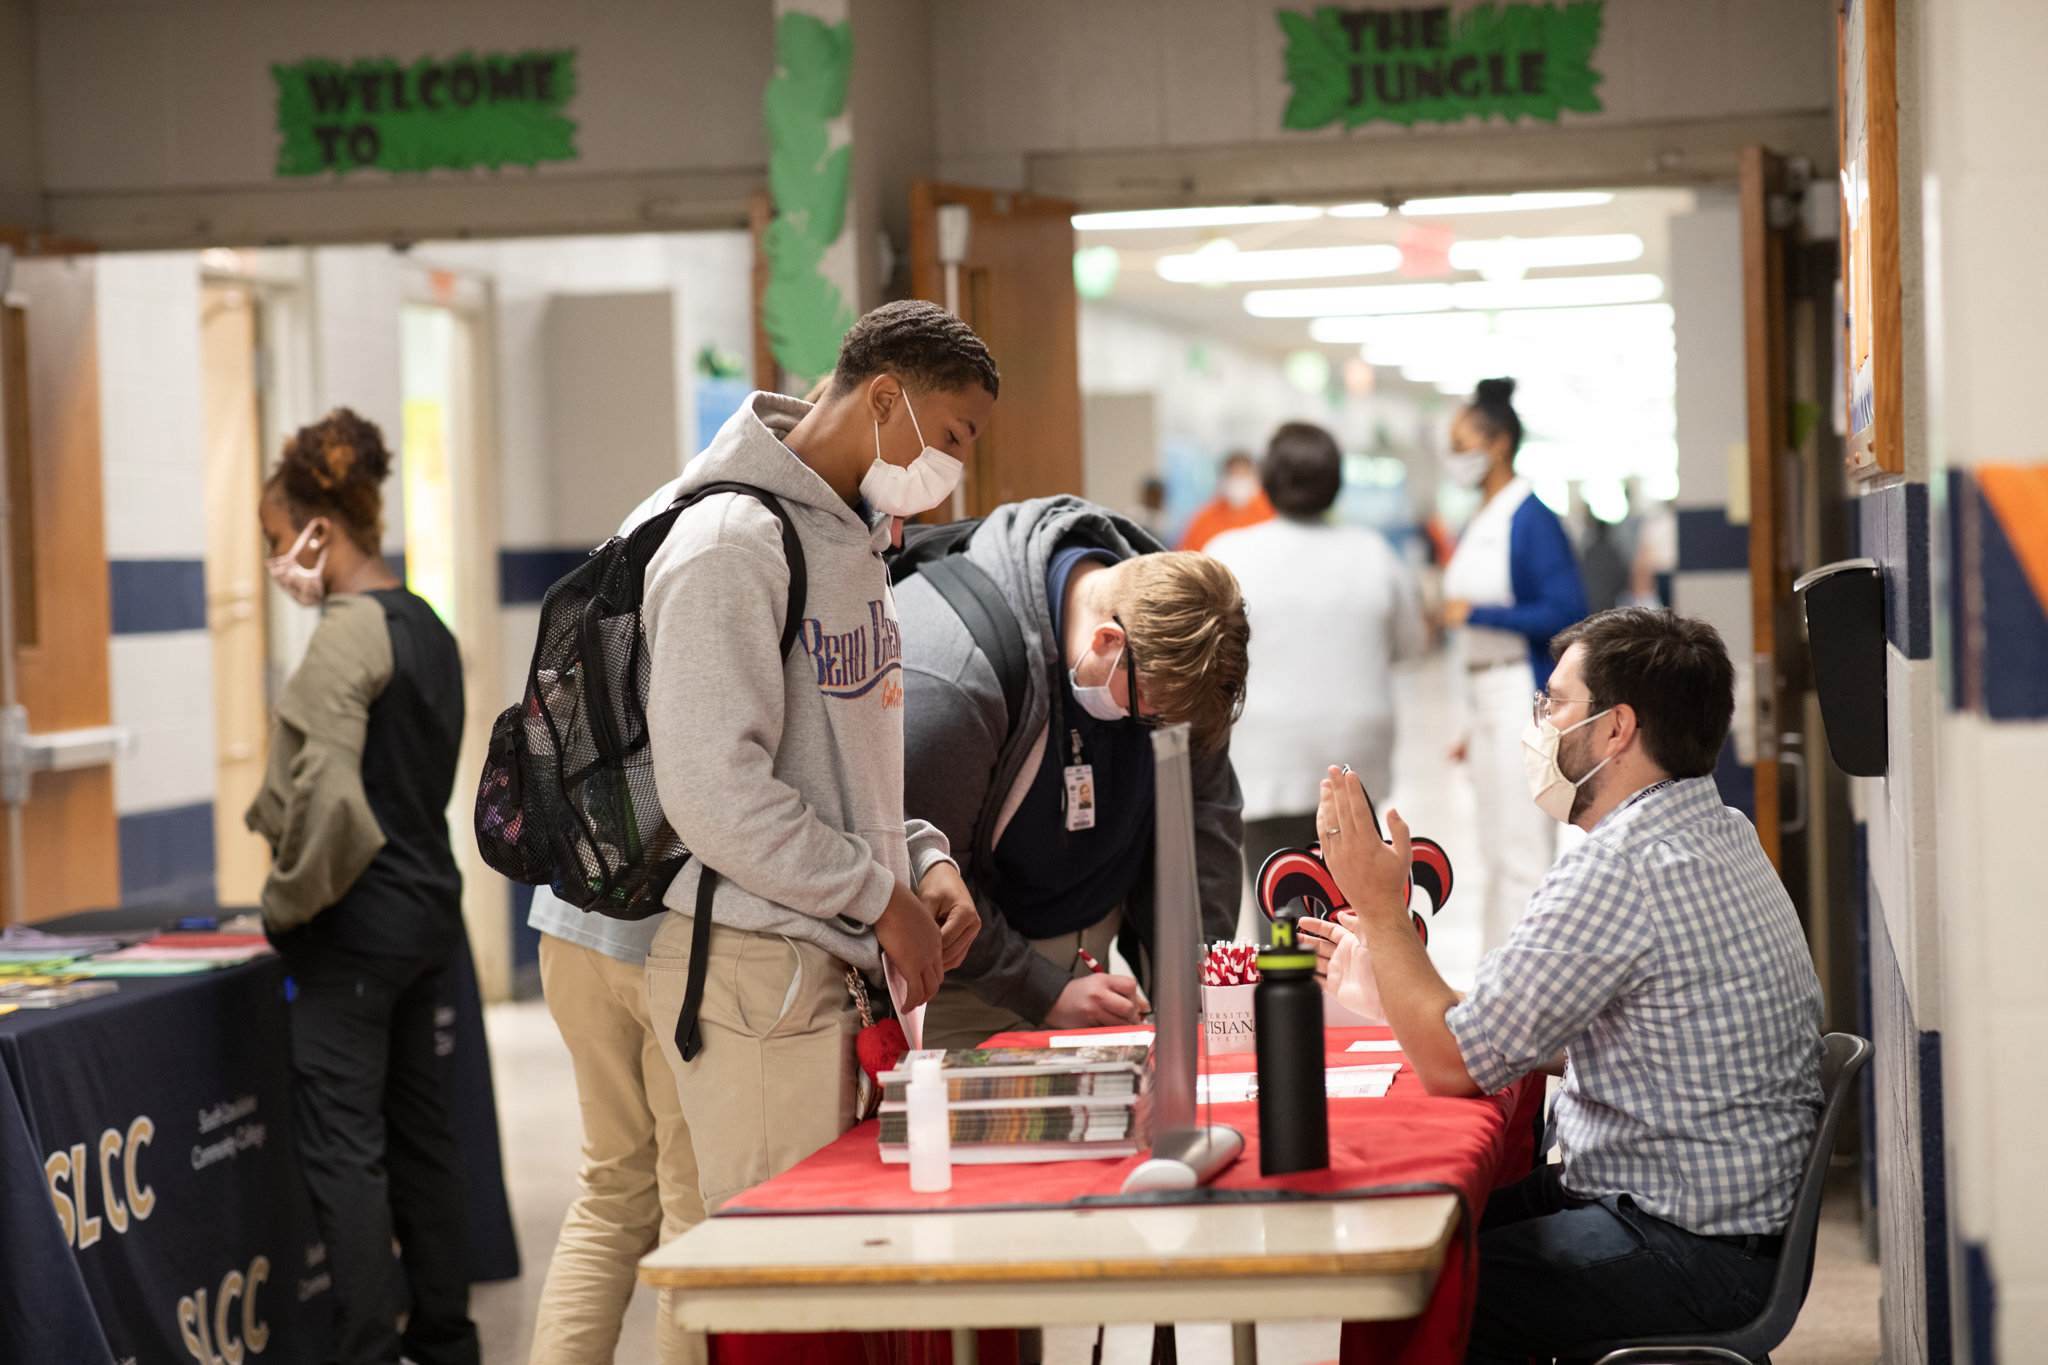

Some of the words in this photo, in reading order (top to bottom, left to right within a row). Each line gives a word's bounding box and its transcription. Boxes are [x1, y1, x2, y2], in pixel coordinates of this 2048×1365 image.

[1341, 7, 1446, 50] THE
[307, 60, 555, 113] WELCOME
[1347, 51, 1543, 105] JUNGLE
[313, 123, 379, 166] TO
[799, 618, 867, 688] BEAU
[44, 1114, 157, 1250] SLCC
[177, 1255, 271, 1365] SLCC
